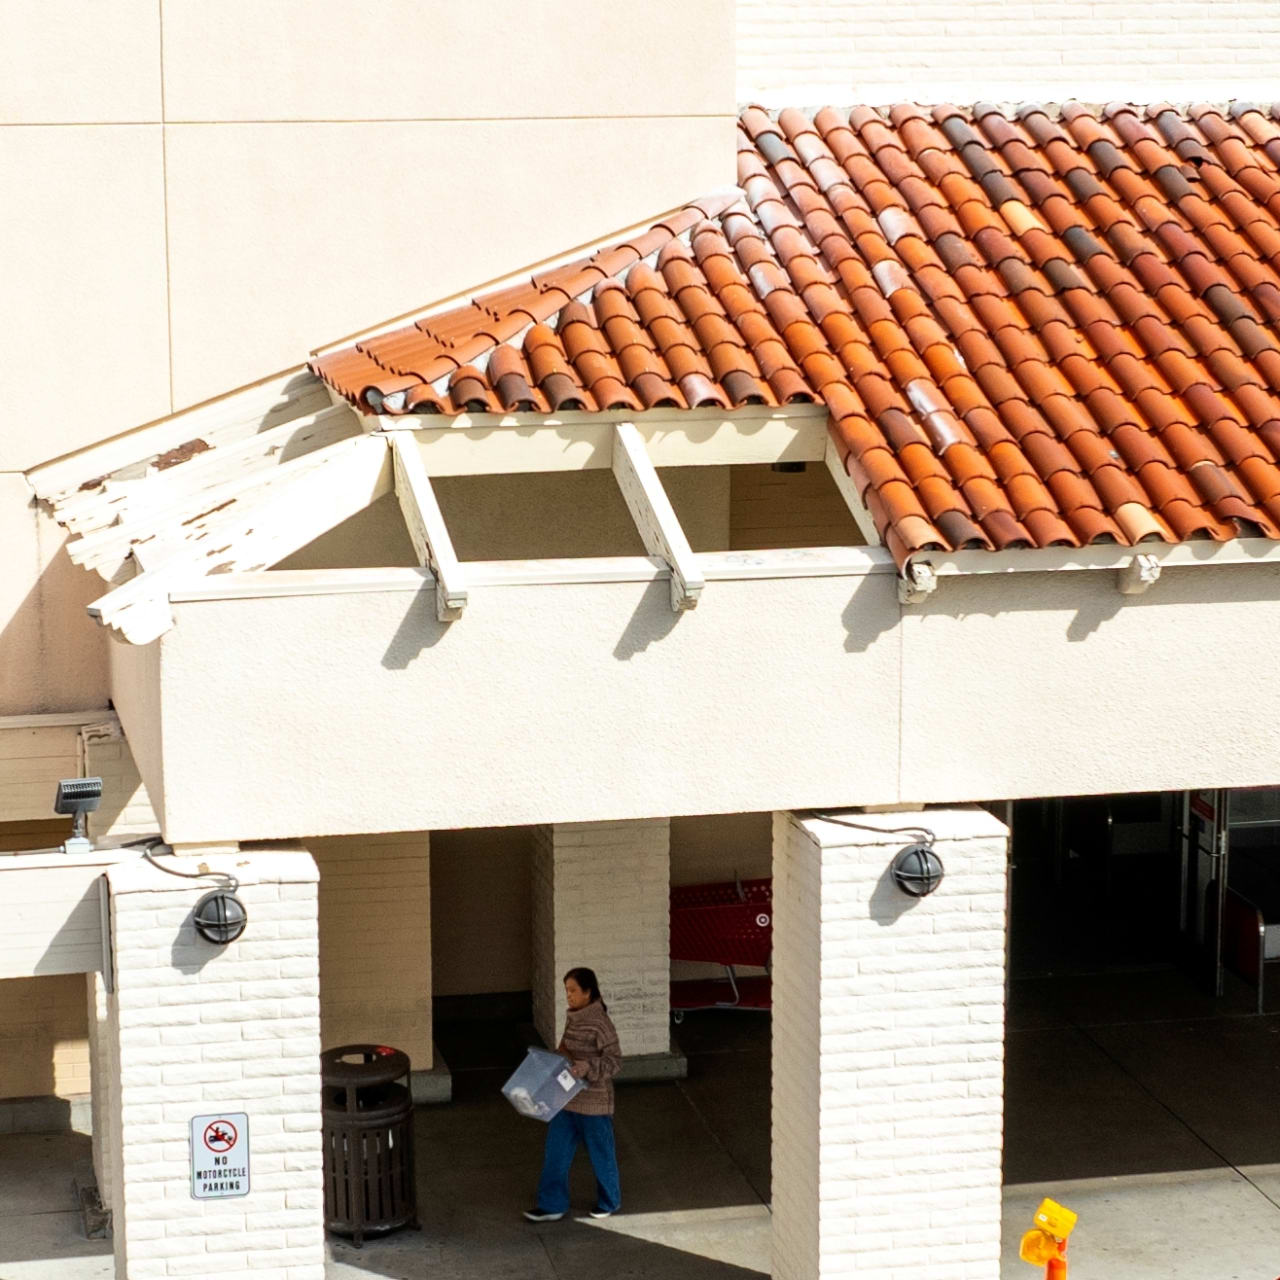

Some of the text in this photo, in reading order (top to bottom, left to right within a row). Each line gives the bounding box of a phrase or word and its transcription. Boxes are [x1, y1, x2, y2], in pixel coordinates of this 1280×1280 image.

[214, 1156, 227, 1165] NO
[196, 1167, 246, 1179] MOTORCYCLE
[203, 1181, 240, 1191] PARKING
